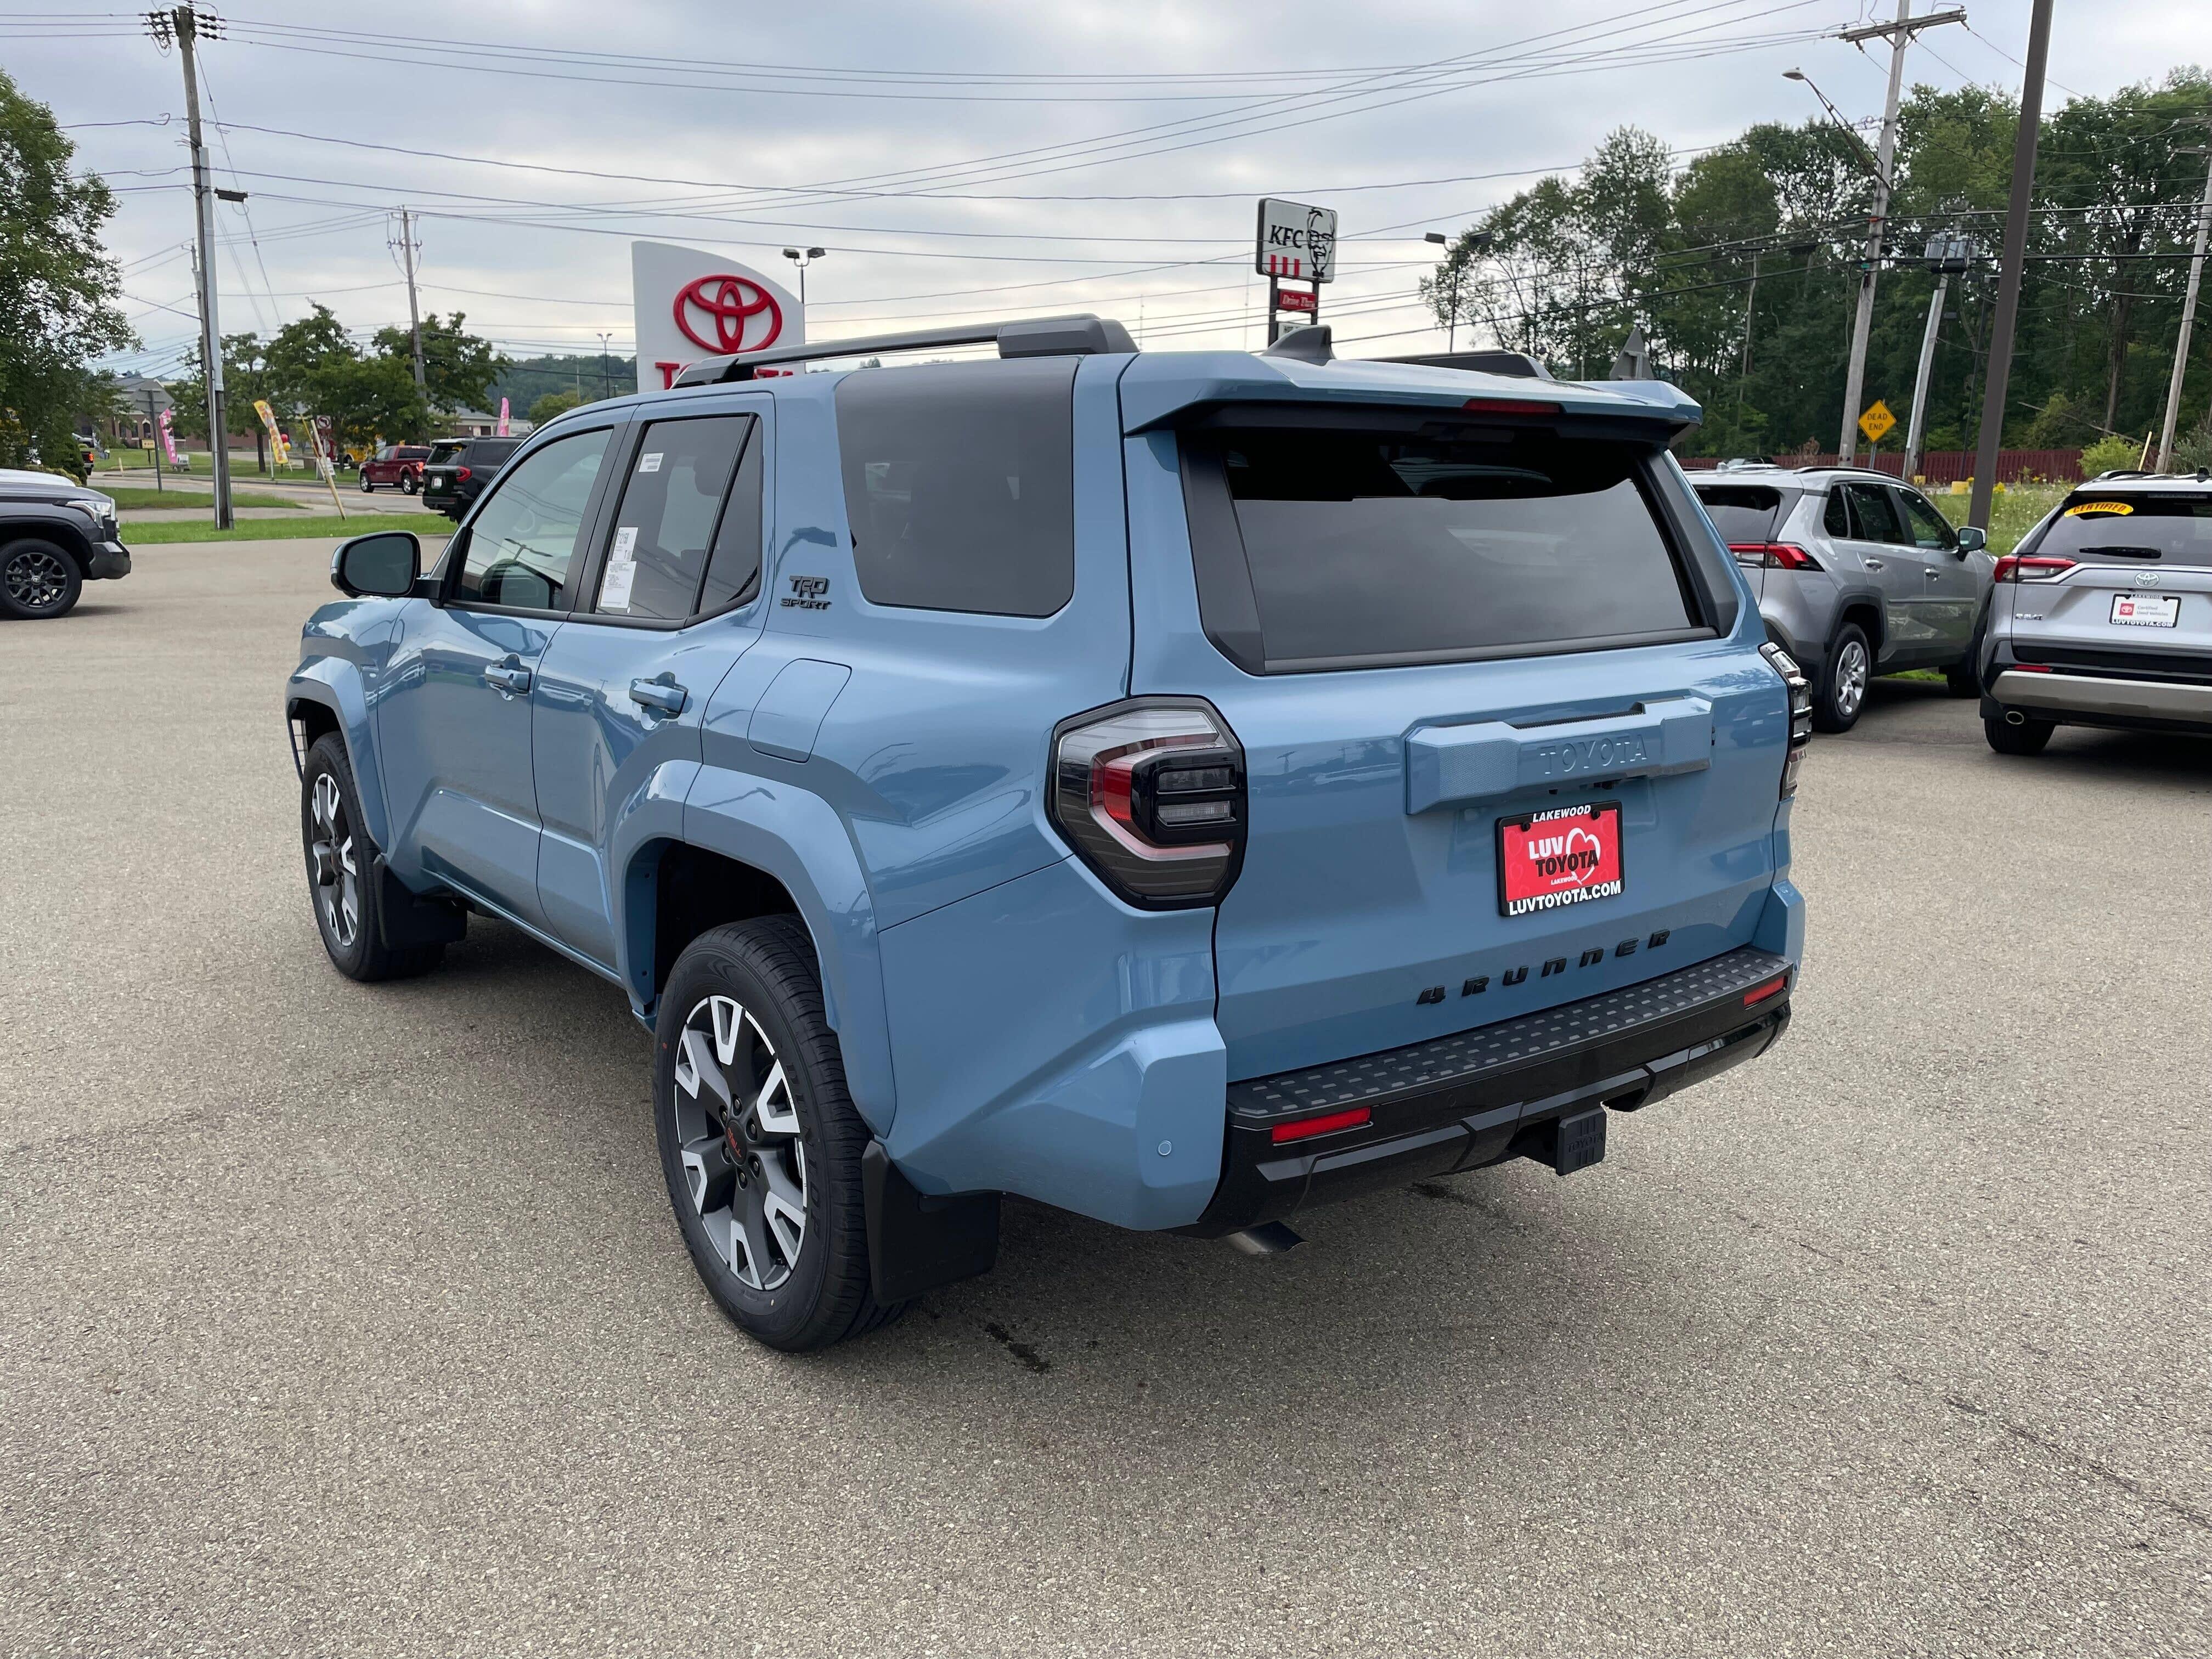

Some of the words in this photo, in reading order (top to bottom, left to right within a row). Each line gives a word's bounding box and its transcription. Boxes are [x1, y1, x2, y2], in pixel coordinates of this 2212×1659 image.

[1268, 224, 1304, 249] KFC
[1867, 413, 1888, 421] DEAD
[1869, 422, 1884, 431] END
[2073, 503, 2127, 514] CERTIFIED
[789, 575, 830, 599] TRD
[780, 597, 832, 610] SPORT
[2112, 618, 2174, 628] LUVTOYOTA.COM
[1540, 734, 1647, 775] TOYOTA
[1532, 804, 1592, 823] LAKEWOOD
[1528, 836, 1564, 860] LUV
[1535, 849, 1599, 878] TOYOTA
[1550, 875, 1578, 886] LAKEWOOD
[1509, 879, 1622, 916] LUVTOYOTA.COM
[1416, 929, 1671, 1005] 4RUNNER
[1568, 1132, 1604, 1153] TOYOTA
